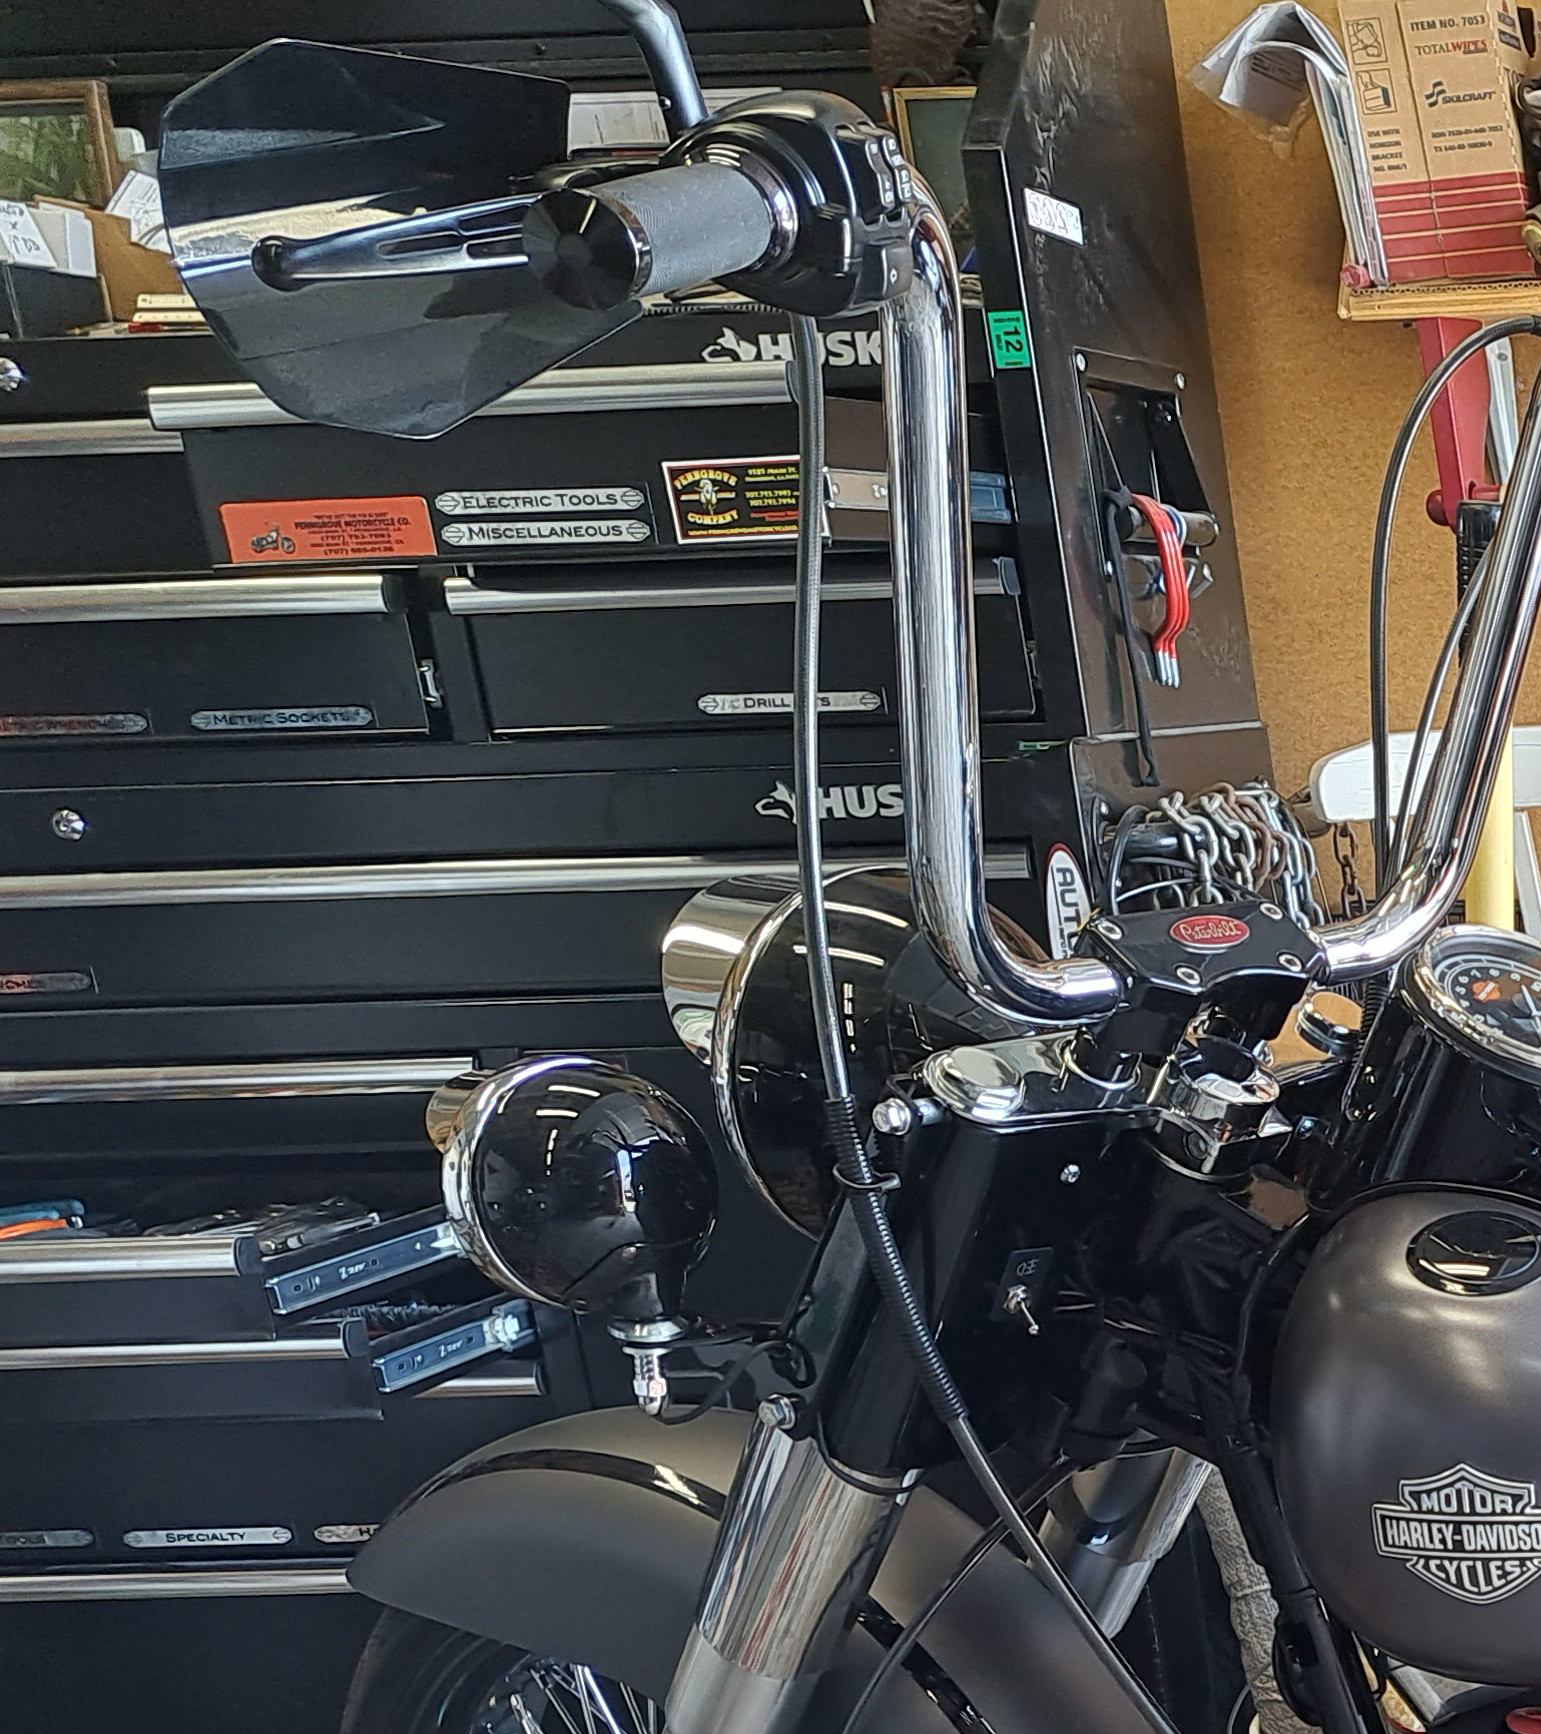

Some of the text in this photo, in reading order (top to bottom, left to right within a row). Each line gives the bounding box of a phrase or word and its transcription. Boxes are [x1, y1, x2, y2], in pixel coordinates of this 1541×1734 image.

[1410, 15, 1486, 32] ITEM NO. 7053
[1415, 39, 1488, 55] TOTALWIPES
[1441, 92, 1494, 105] SKILCRAFT
[1003, 325, 1024, 353] 12
[462, 493, 618, 509] ELECTRIC TOOLS
[687, 509, 740, 525] COMPANY
[466, 525, 623, 541] MISCELLANEOUS
[743, 697, 792, 709] DRILL
[1178, 920, 1242, 940] Peterbilt
[1420, 1480, 1513, 1514] MOTOR
[166, 1531, 246, 1544] SPECIALTY
[1428, 1559, 1528, 1594] CYCLES
